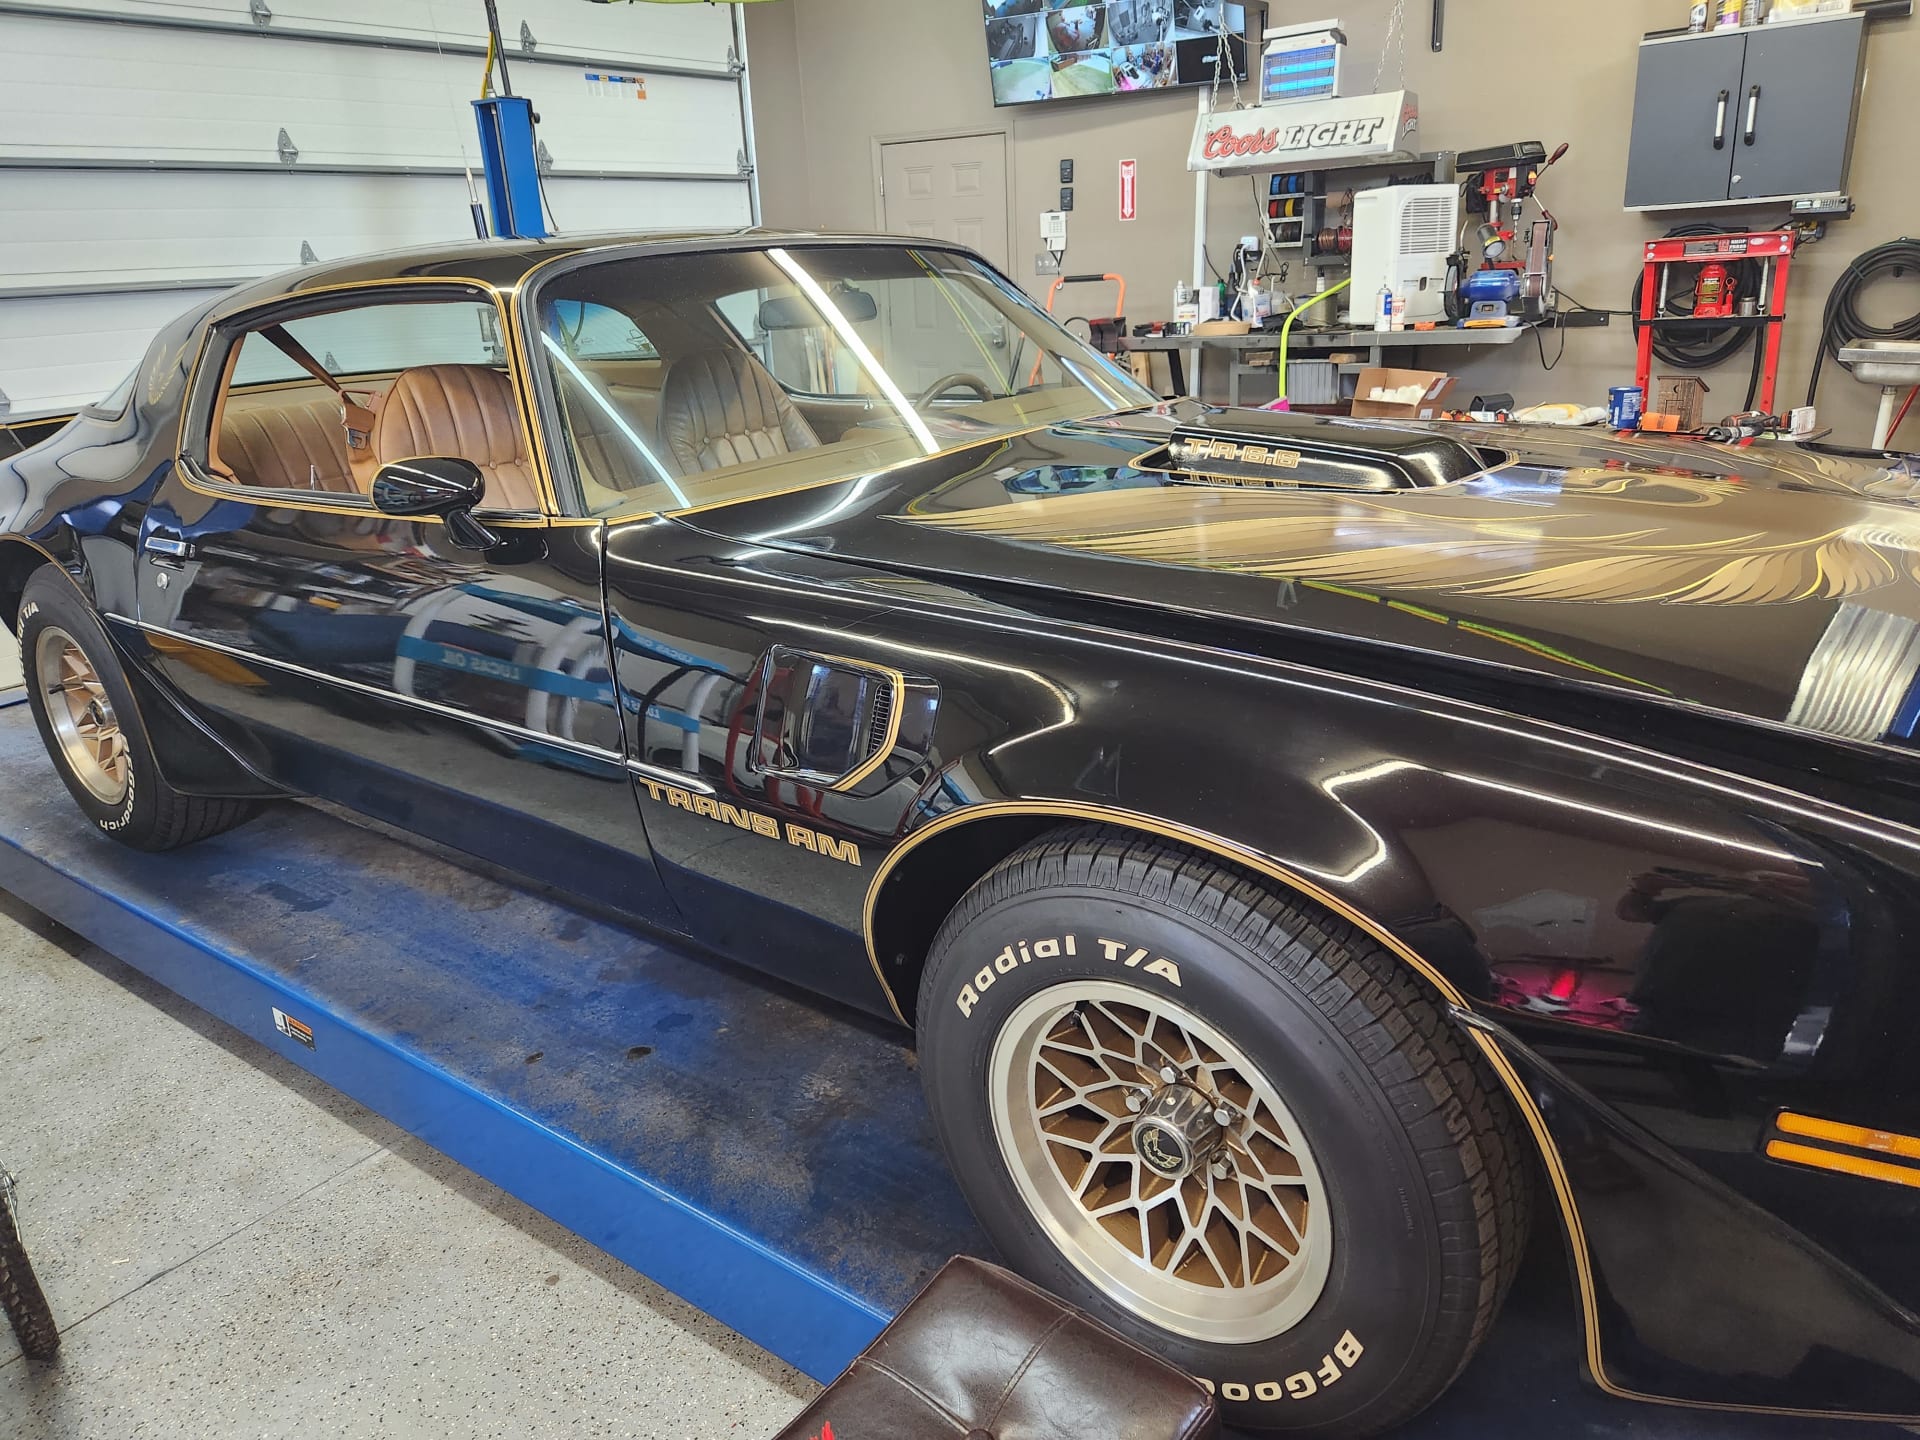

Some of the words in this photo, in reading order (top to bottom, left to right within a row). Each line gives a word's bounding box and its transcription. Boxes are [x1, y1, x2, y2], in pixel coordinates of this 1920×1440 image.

[1202, 125, 1279, 160] Coors
[1279, 117, 1384, 151] LIGHT
[1184, 437, 1238, 460] T/A
[1240, 444, 1301, 469] 6.6
[22, 601, 40, 619] T/A
[639, 776, 781, 841] TRANS
[785, 822, 862, 867] AM
[956, 933, 1077, 1019] Radial
[1097, 936, 1183, 988] T/A
